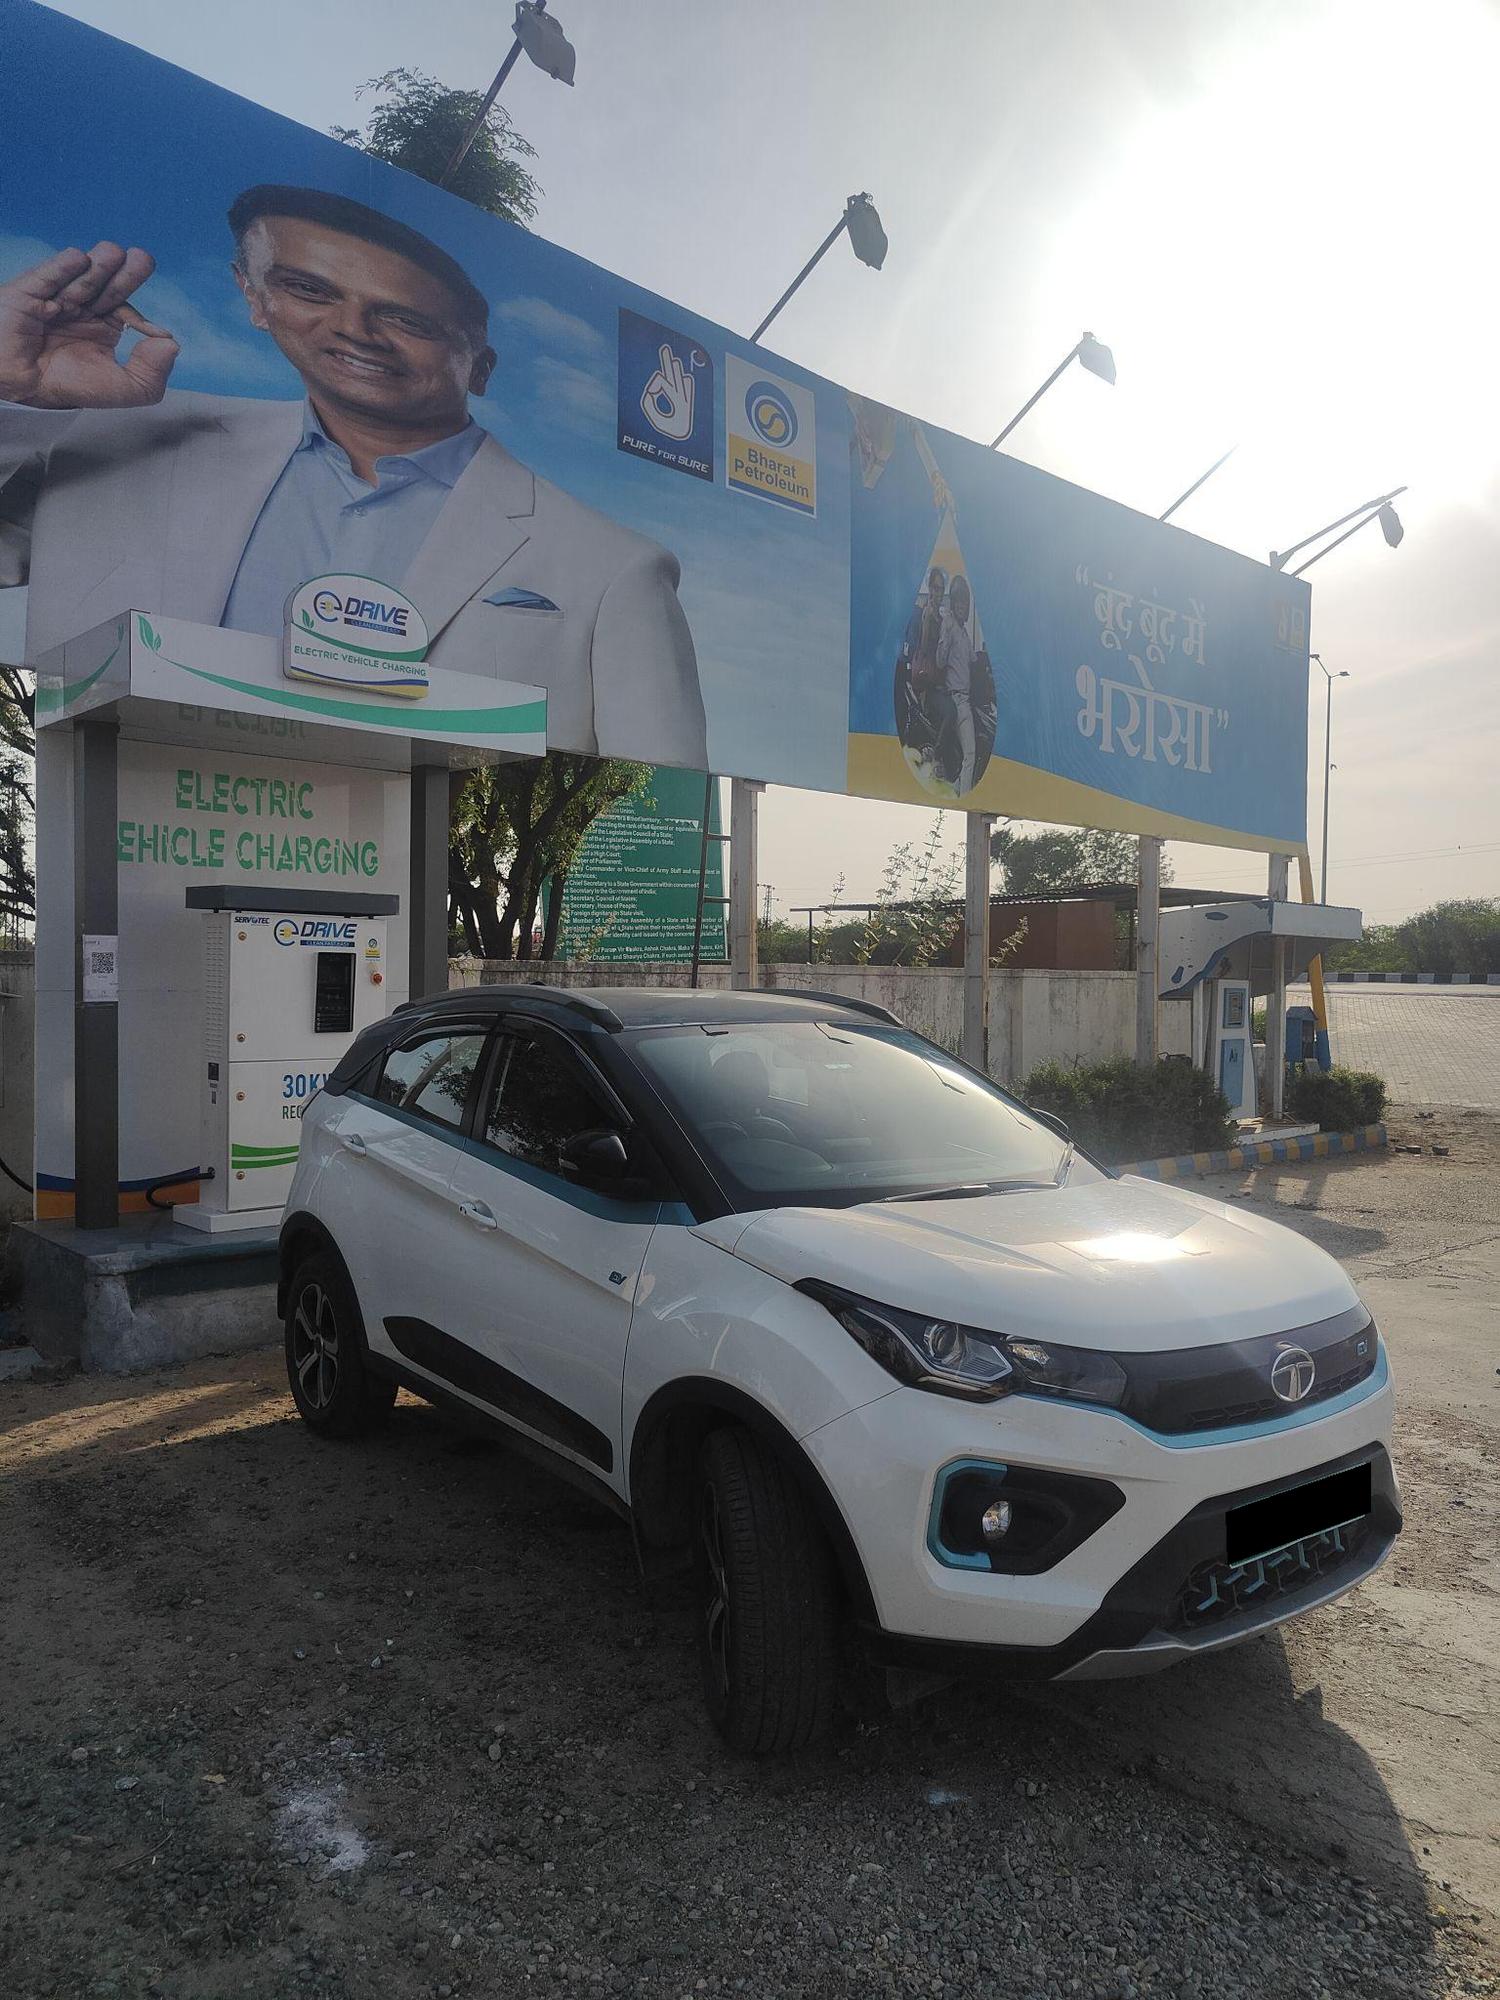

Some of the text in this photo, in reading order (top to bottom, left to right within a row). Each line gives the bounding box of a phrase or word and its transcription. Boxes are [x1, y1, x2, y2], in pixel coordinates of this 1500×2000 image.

[623, 435, 709, 474] PURE FOR SURE
[748, 447, 797, 479] Bharat
[734, 459, 809, 498] Petroleum
[344, 597, 409, 626] DRIVE
[294, 645, 427, 677] ELECTRIC VEHICLE CHARGING
[176, 769, 314, 820] ELECTRIC
[117, 821, 379, 877] EHICLE CHARGING
[301, 922, 358, 939] DRIVE
